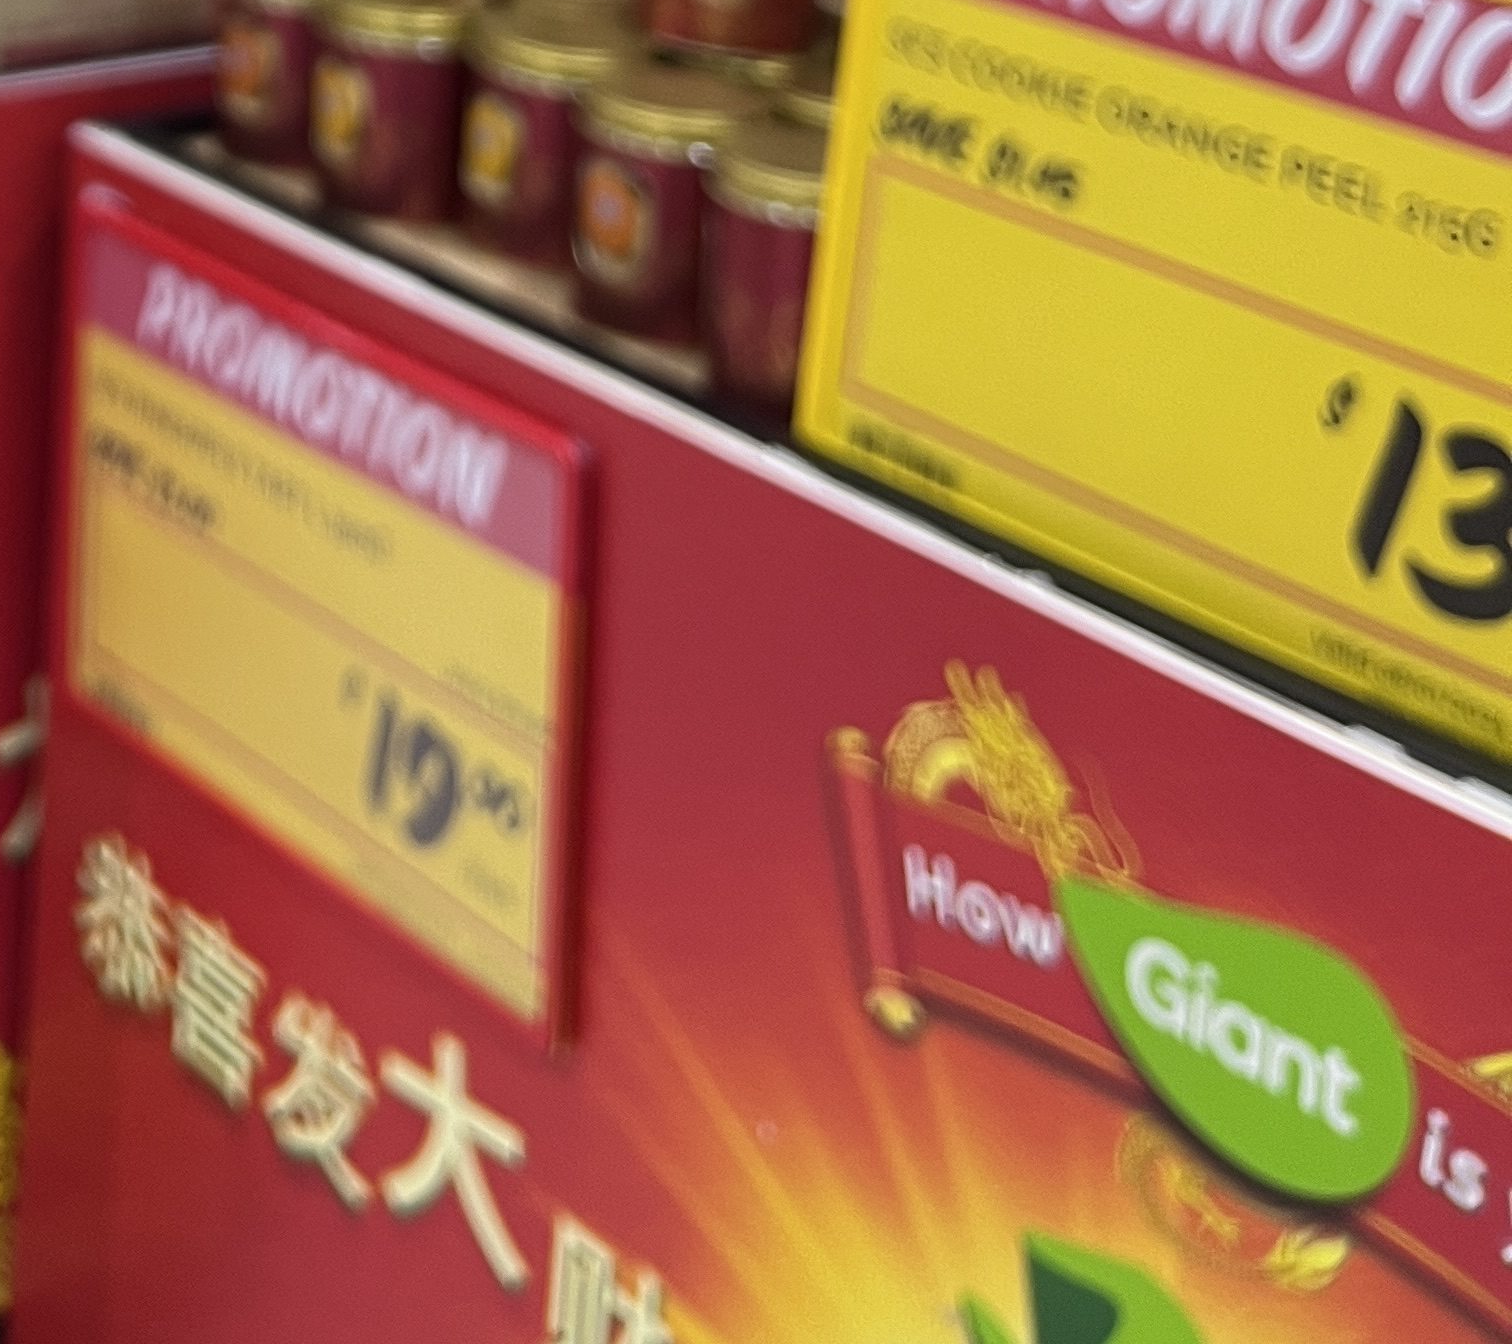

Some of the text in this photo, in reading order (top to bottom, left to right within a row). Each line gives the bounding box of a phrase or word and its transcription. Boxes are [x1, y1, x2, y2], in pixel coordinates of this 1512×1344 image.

[1094, 85, 1278, 186] ORANGE
[1280, 145, 1389, 225] PEEL
[133, 264, 511, 527] PROMOTION
[901, 844, 1488, 1212] How Giant is
